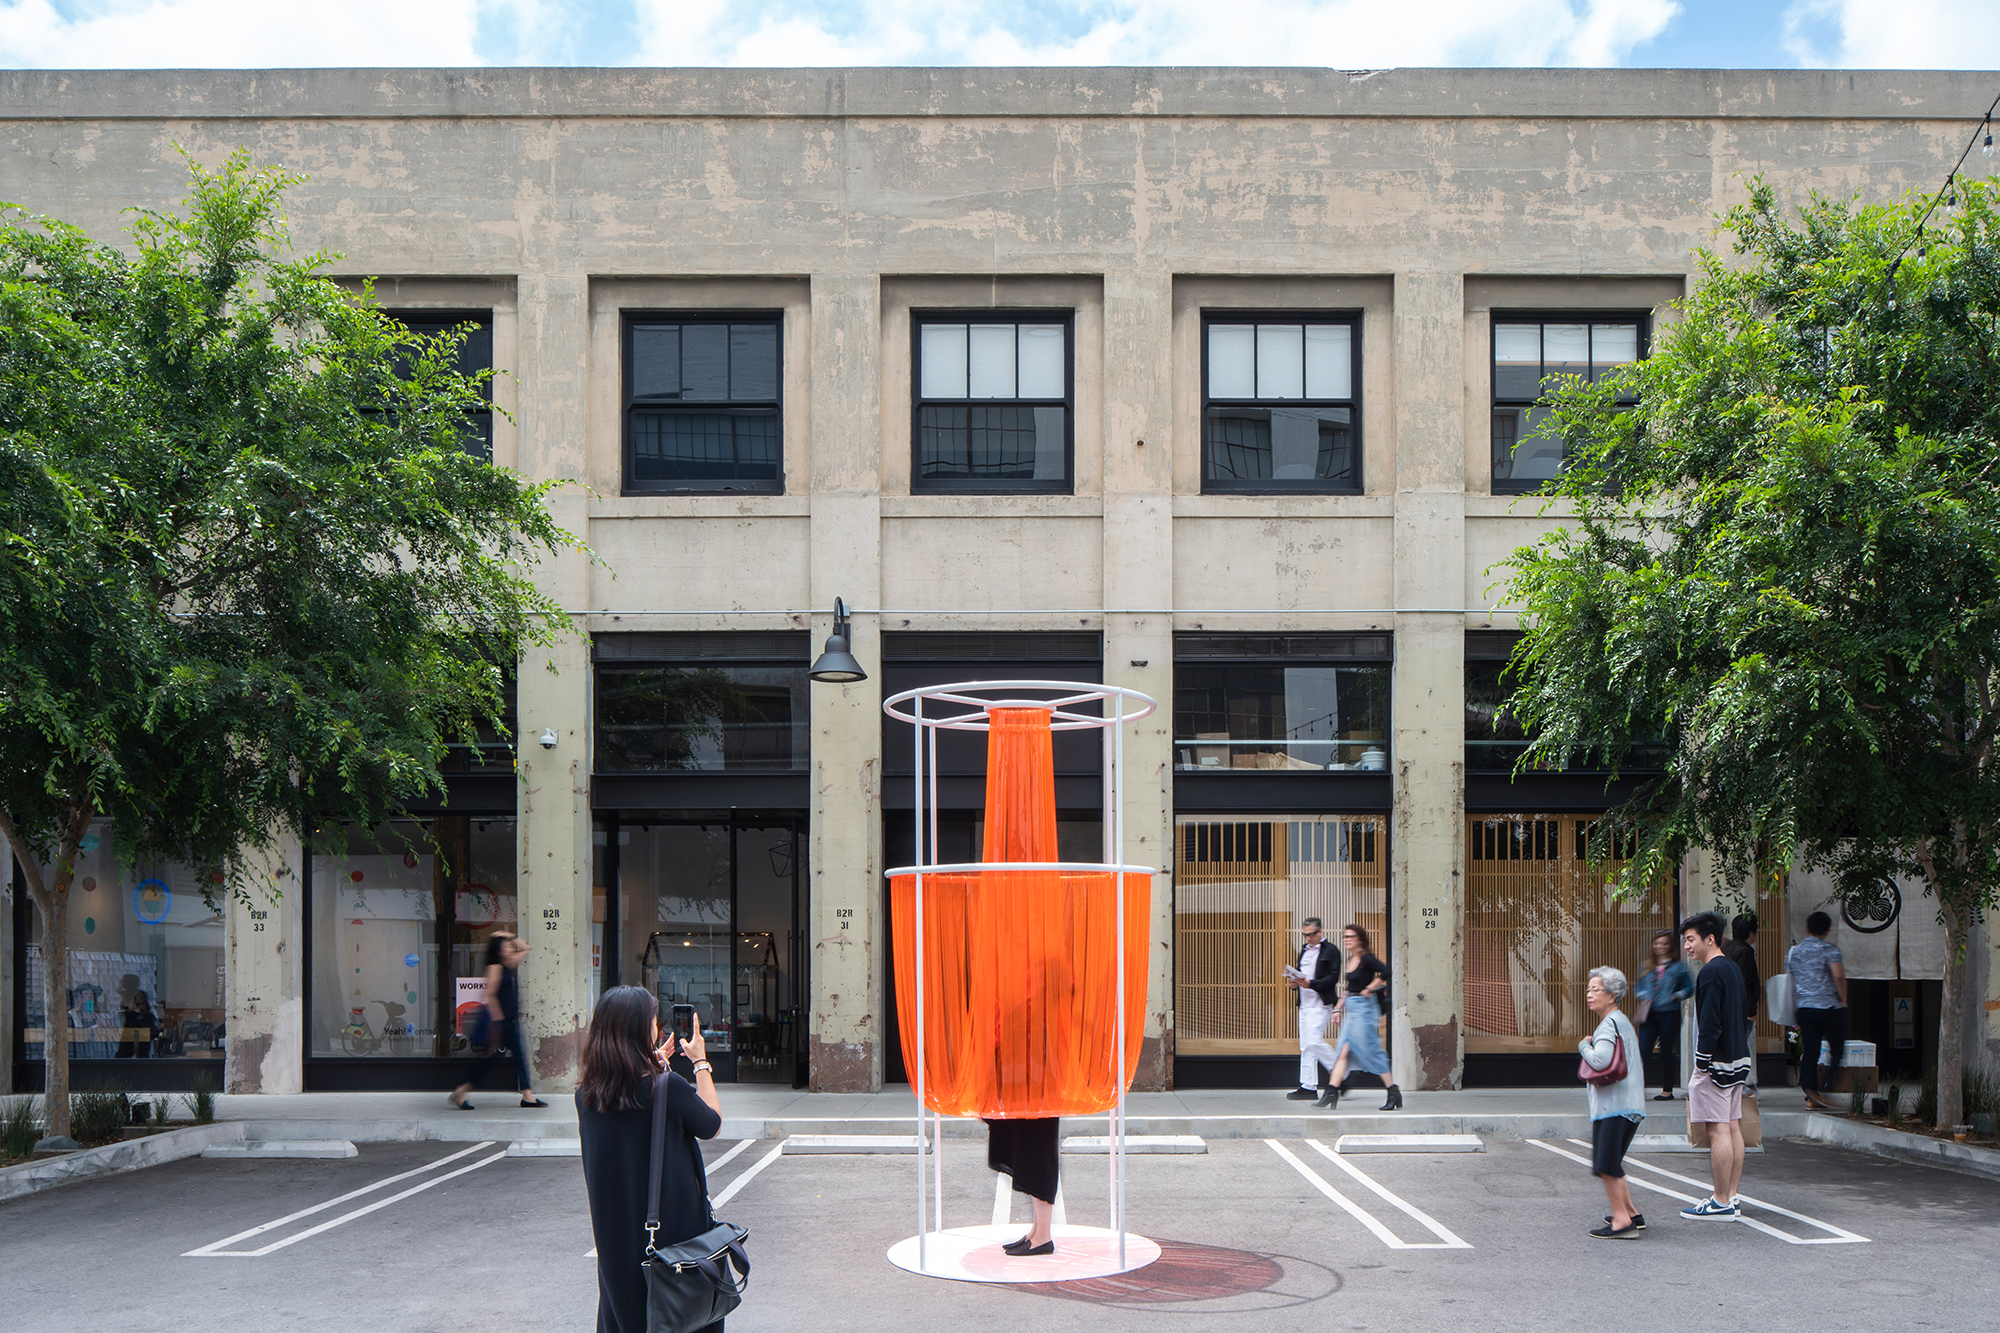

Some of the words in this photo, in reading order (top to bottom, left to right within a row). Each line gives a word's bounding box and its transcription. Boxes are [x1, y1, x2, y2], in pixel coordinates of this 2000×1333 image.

[251, 911, 267, 919] B2R
[543, 909, 560, 918] B2R
[836, 909, 853, 917] B2R
[1422, 908, 1439, 916] B2R
[254, 923, 264, 931] 33
[546, 922, 557, 930] 32
[840, 921, 848, 929] 31
[1425, 920, 1436, 928] 29
[1898, 999, 1909, 1011] A
[384, 1027, 406, 1035] Yeah!
